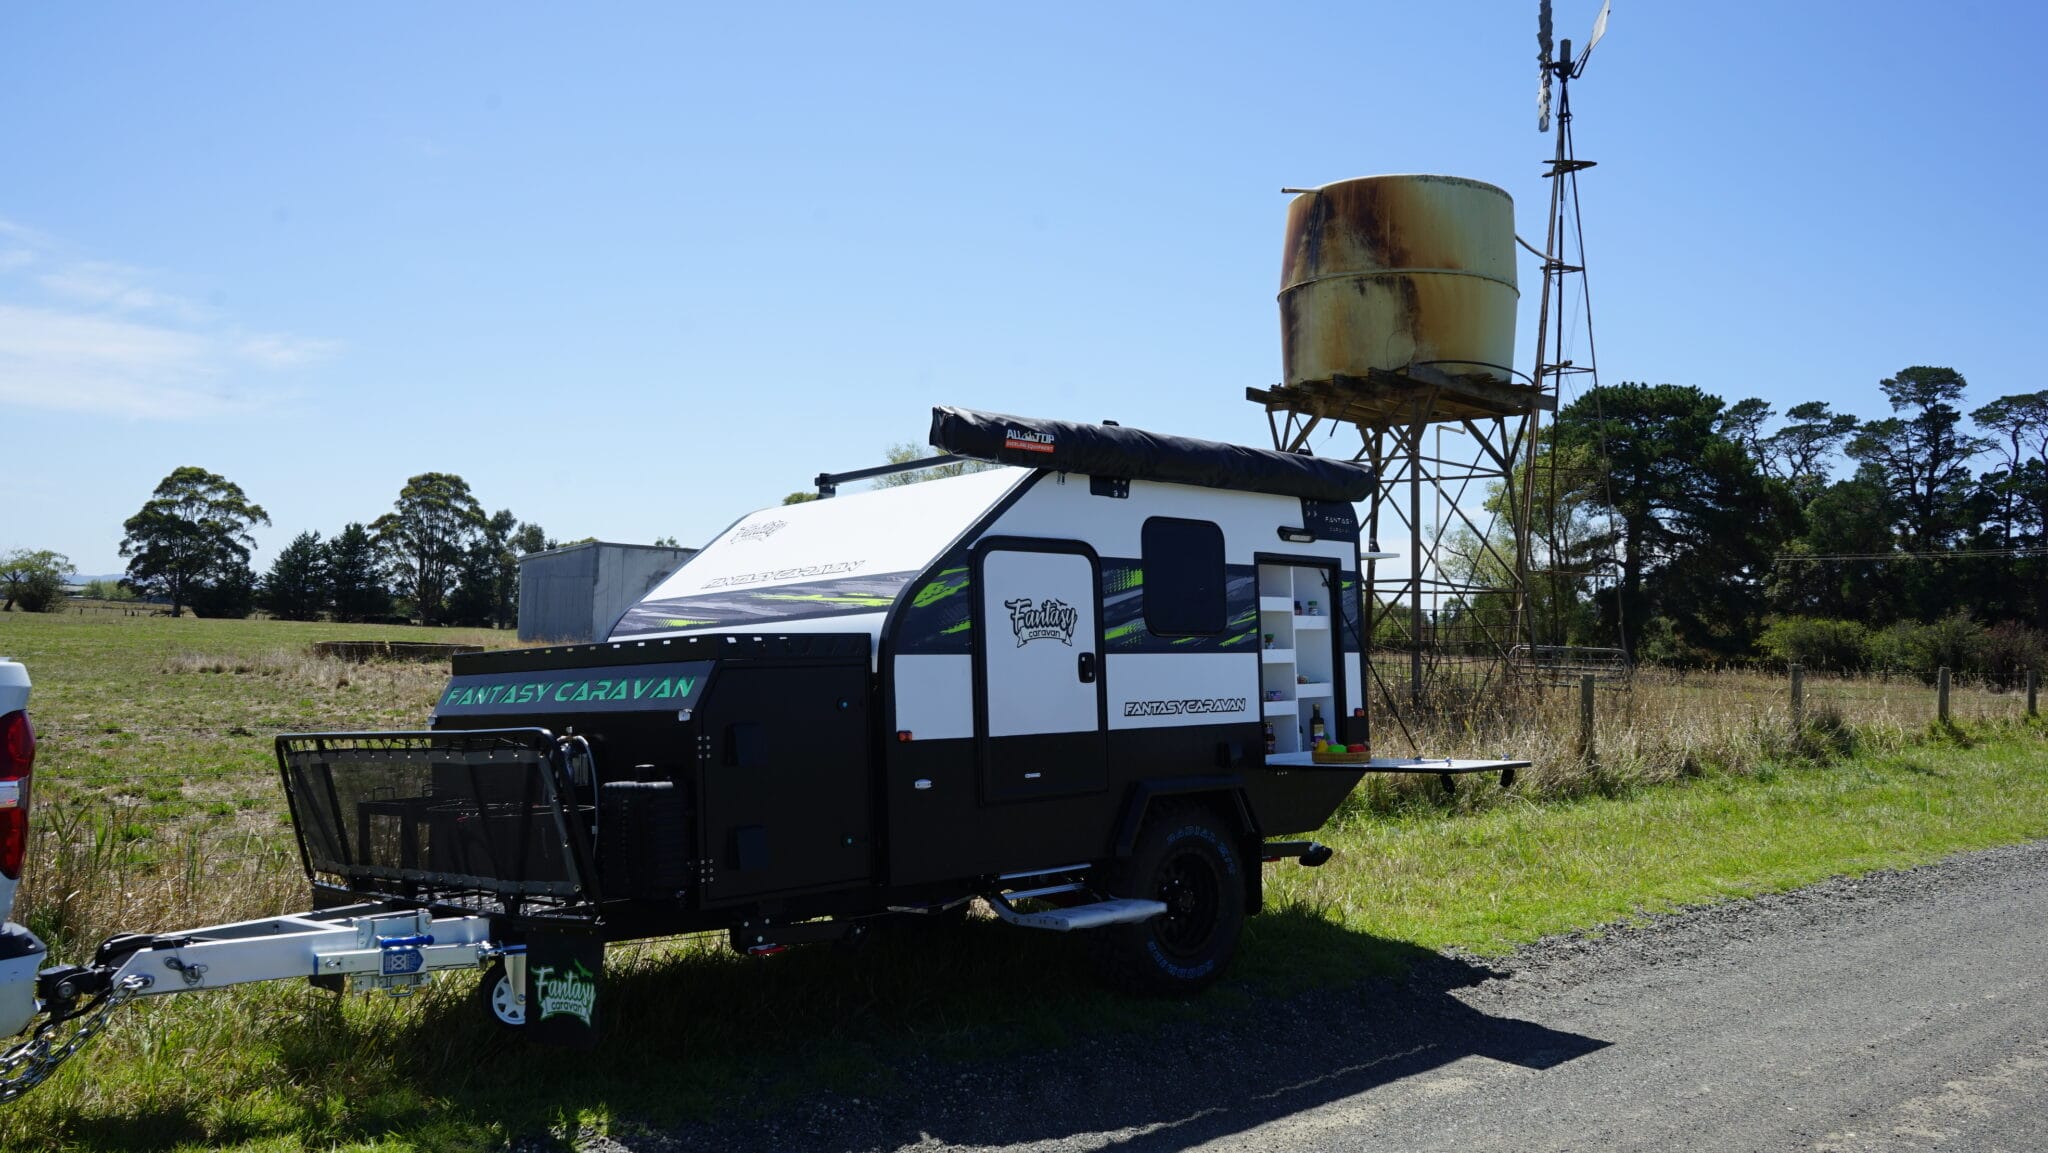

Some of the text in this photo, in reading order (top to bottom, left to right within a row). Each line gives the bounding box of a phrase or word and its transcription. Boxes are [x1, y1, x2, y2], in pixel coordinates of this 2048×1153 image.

[1004, 598, 1077, 637] Fantasy
[1028, 629, 1061, 638] caravan
[444, 675, 695, 706] FANTASY CARAVAN
[530, 965, 596, 1016] Fantasy
[551, 1001, 583, 1012] caravan
